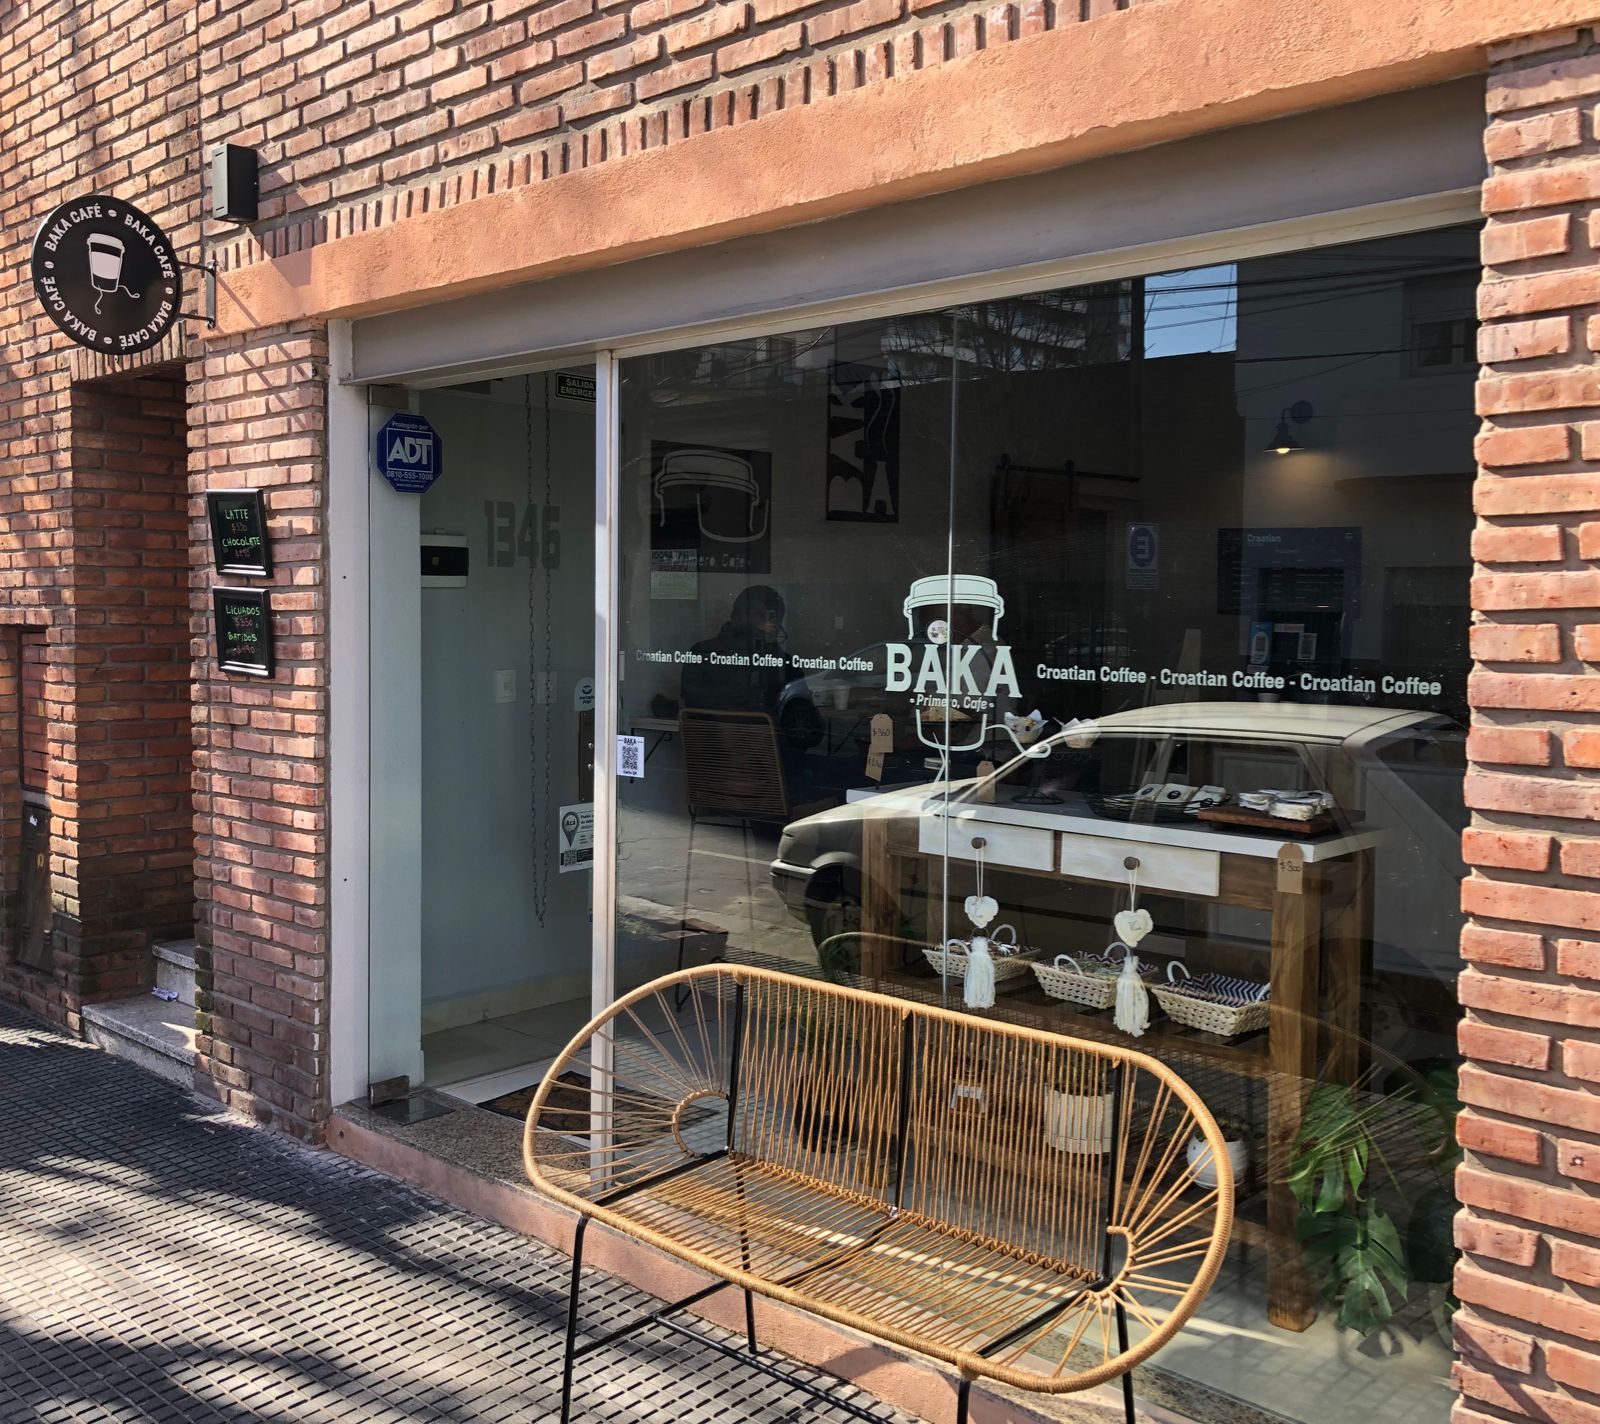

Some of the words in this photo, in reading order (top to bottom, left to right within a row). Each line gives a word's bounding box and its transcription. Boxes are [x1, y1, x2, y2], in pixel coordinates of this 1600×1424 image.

[44, 219, 72, 252] BAKA
[69, 203, 102, 223] CAFÉ
[124, 213, 155, 246] BAKA
[153, 245, 176, 279] CAFÉ
[40, 276, 64, 312] CAFÉ
[63, 309, 98, 342] BAKA
[146, 300, 172, 334] BAKA
[118, 326, 150, 350] CAFÉ
[566, 378, 595, 390] SALIDA
[388, 436, 432, 465] ADT
[224, 508, 249, 520] LATTE
[222, 536, 262, 547] CHOCOLATE
[484, 500, 561, 570] 1346
[636, 650, 672, 663] Croatian
[674, 650, 703, 664] Coffee
[710, 652, 750, 666] Croatian
[752, 653, 784, 668] Coffee
[792, 654, 837, 671] Croatian
[838, 657, 874, 672] Coffee
[885, 642, 1023, 698] BAKA
[1036, 663, 1096, 682] Croatian
[1099, 665, 1147, 684] Coffee
[1160, 668, 1228, 688] Croatian
[1231, 670, 1285, 690] Coffee
[1300, 672, 1376, 694] Croatian
[1381, 675, 1442, 697] Coffee
[915, 693, 961, 710] Primeo,
